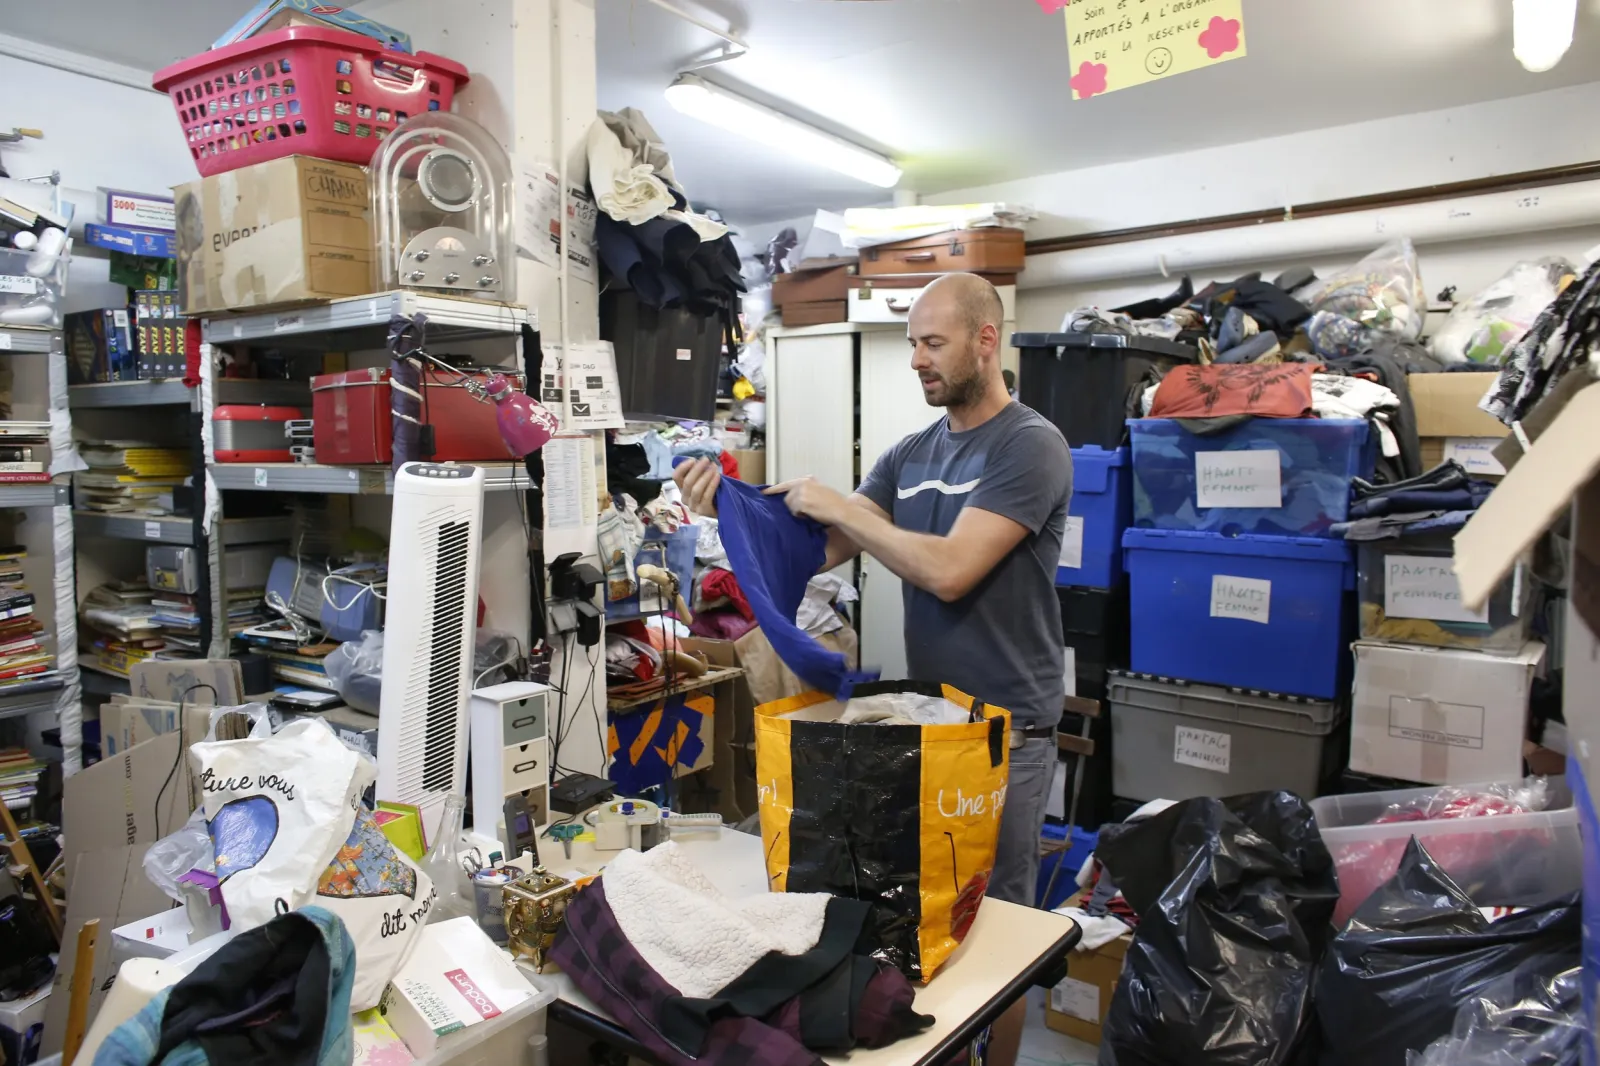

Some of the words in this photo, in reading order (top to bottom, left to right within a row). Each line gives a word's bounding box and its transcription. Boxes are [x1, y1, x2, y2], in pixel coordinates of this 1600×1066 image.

[1094, 50, 1107, 61] DE
[1121, 40, 1132, 52] LA
[113, 199, 136, 211] 3000
[937, 788, 987, 818] Une
[381, 908, 407, 939] dit
[455, 973, 493, 1014] bodum
[416, 1002, 440, 1026] TEAPOT
